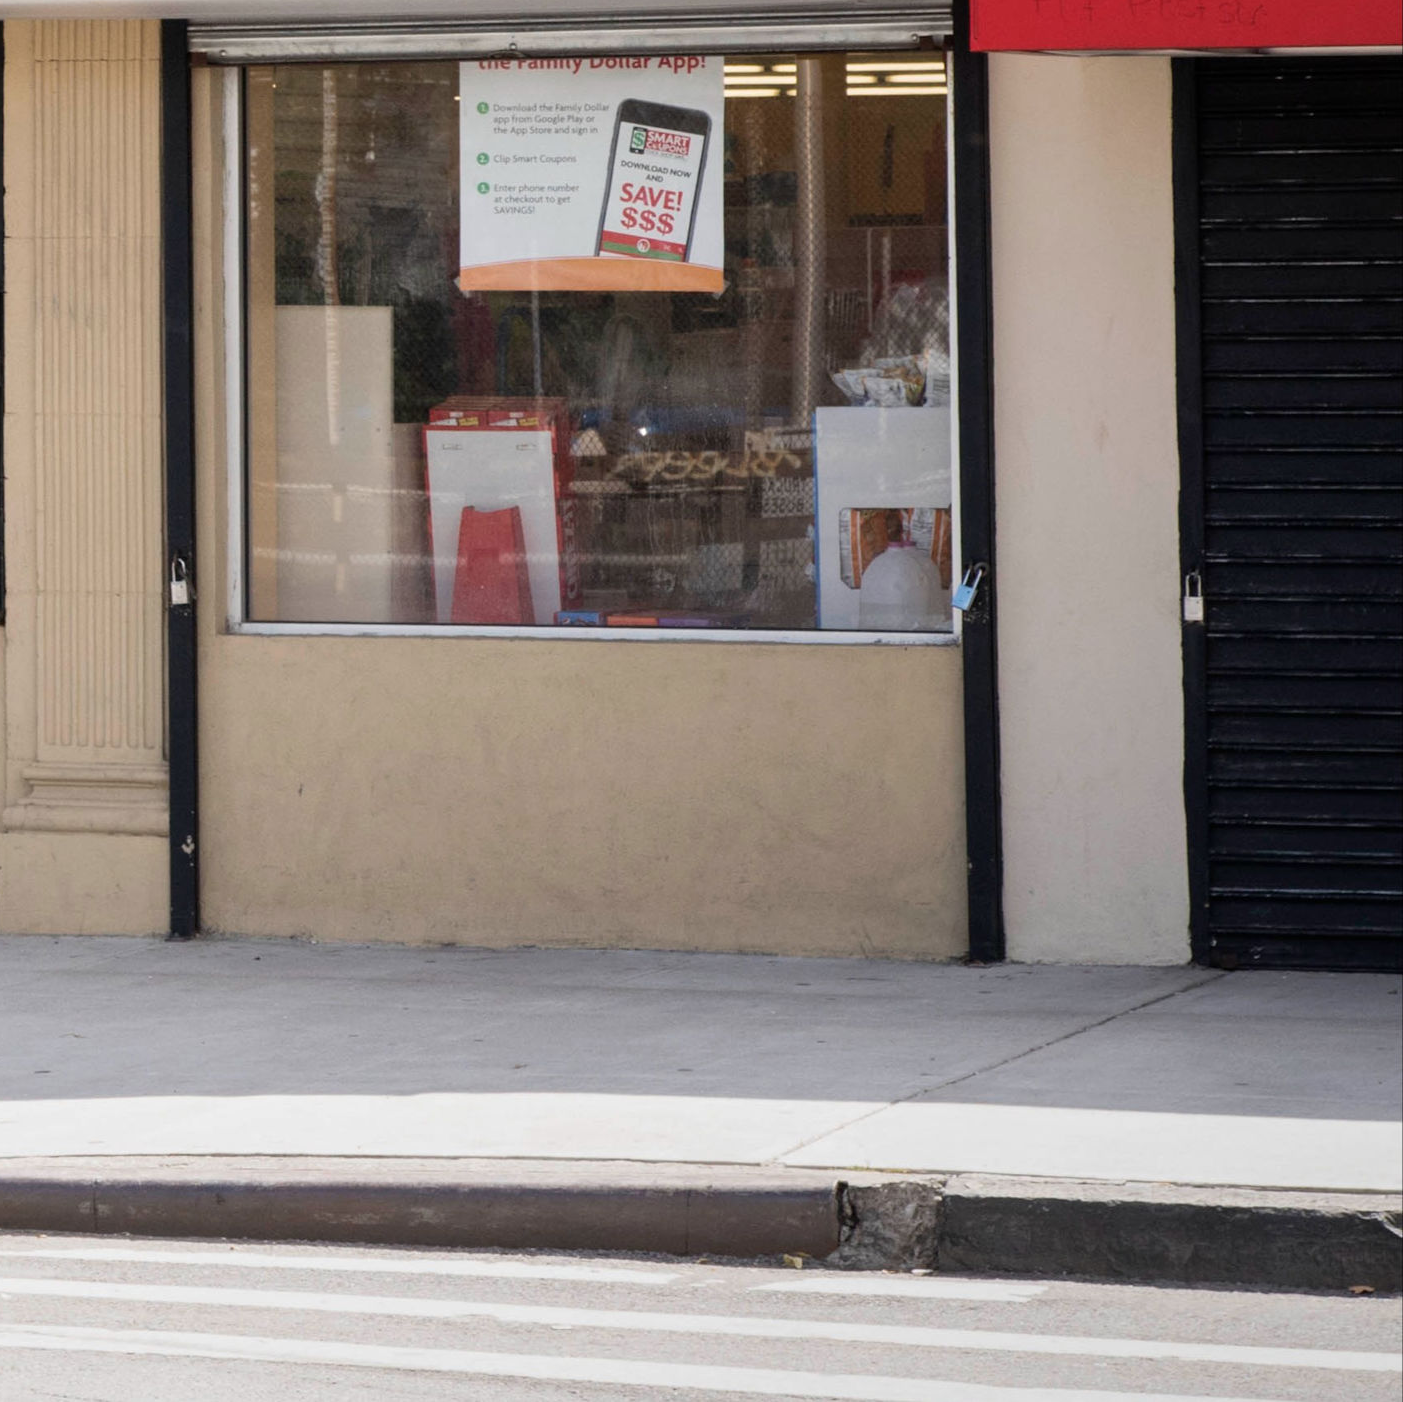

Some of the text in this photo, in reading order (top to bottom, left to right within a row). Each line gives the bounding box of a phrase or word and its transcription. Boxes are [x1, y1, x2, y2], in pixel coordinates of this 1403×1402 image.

[478, 55, 706, 74] the Family Dollar App!
[493, 103, 610, 113] Download the Family Dollar
[493, 116, 510, 125] app
[511, 114, 534, 123] from
[534, 114, 566, 125] Google
[567, 114, 584, 125] Play
[493, 126, 599, 136] the App Store and sign in
[647, 131, 689, 147] SMART
[646, 141, 688, 155] COUPONS
[493, 154, 511, 165] Clip
[512, 154, 538, 163] Smart
[539, 154, 577, 165] Coupons
[620, 160, 692, 178] DOWNLOAD NOW
[646, 174, 664, 183] AND
[493, 183, 580, 194] Enter phone number
[494, 195, 571, 205] at checkout to get
[619, 183, 684, 212] SAVE!
[493, 206, 536, 215] SAVINGS!
[620, 207, 676, 236] $$$
